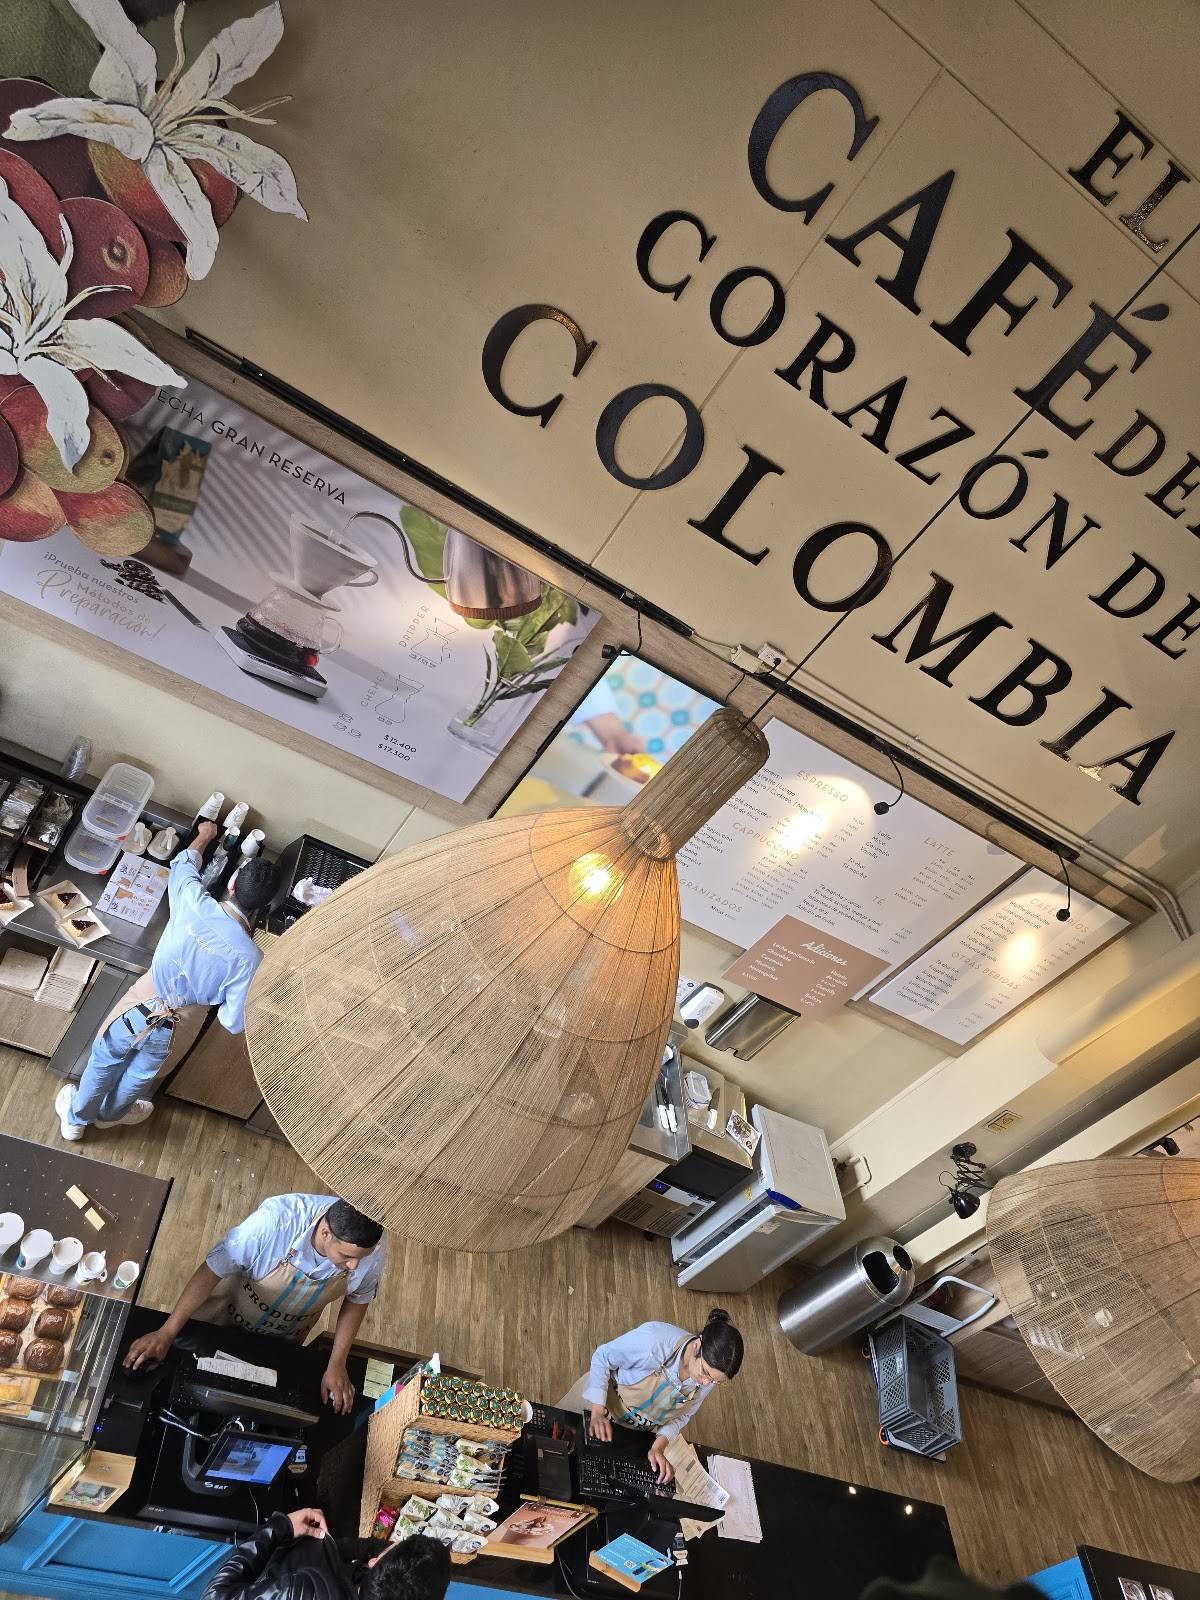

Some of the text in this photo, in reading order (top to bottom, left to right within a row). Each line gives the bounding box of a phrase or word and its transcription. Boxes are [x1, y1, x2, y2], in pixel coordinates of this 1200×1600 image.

[1068, 110, 1192, 254] EL
[747, 71, 1200, 539] CAFÉ DE
[156, 388, 346, 505] ECHA GRAN RESERVA
[635, 210, 1200, 661] CORAZÓN DE
[481, 303, 1179, 806] COLOMBIA
[43, 551, 139, 604] ¡Prueba nuestros
[37, 569, 167, 639] Preparación!
[399, 605, 429, 648] DRIPPER
[360, 669, 387, 708] CHEMEX
[797, 769, 849, 802] ESPRESSO
[732, 822, 800, 860] CAPPUCCINO
[923, 837, 956, 857] LATTE
[679, 878, 744, 913] GRANIZADOS
[872, 895, 887, 906] TÉ
[1030, 898, 1060, 918] CAFÉ
[1065, 917, 1089, 934] RÍOS
[800, 941, 849, 966] Adiciones
[951, 951, 982, 971] OTRAS
[982, 967, 1021, 991] BEBIDAS
